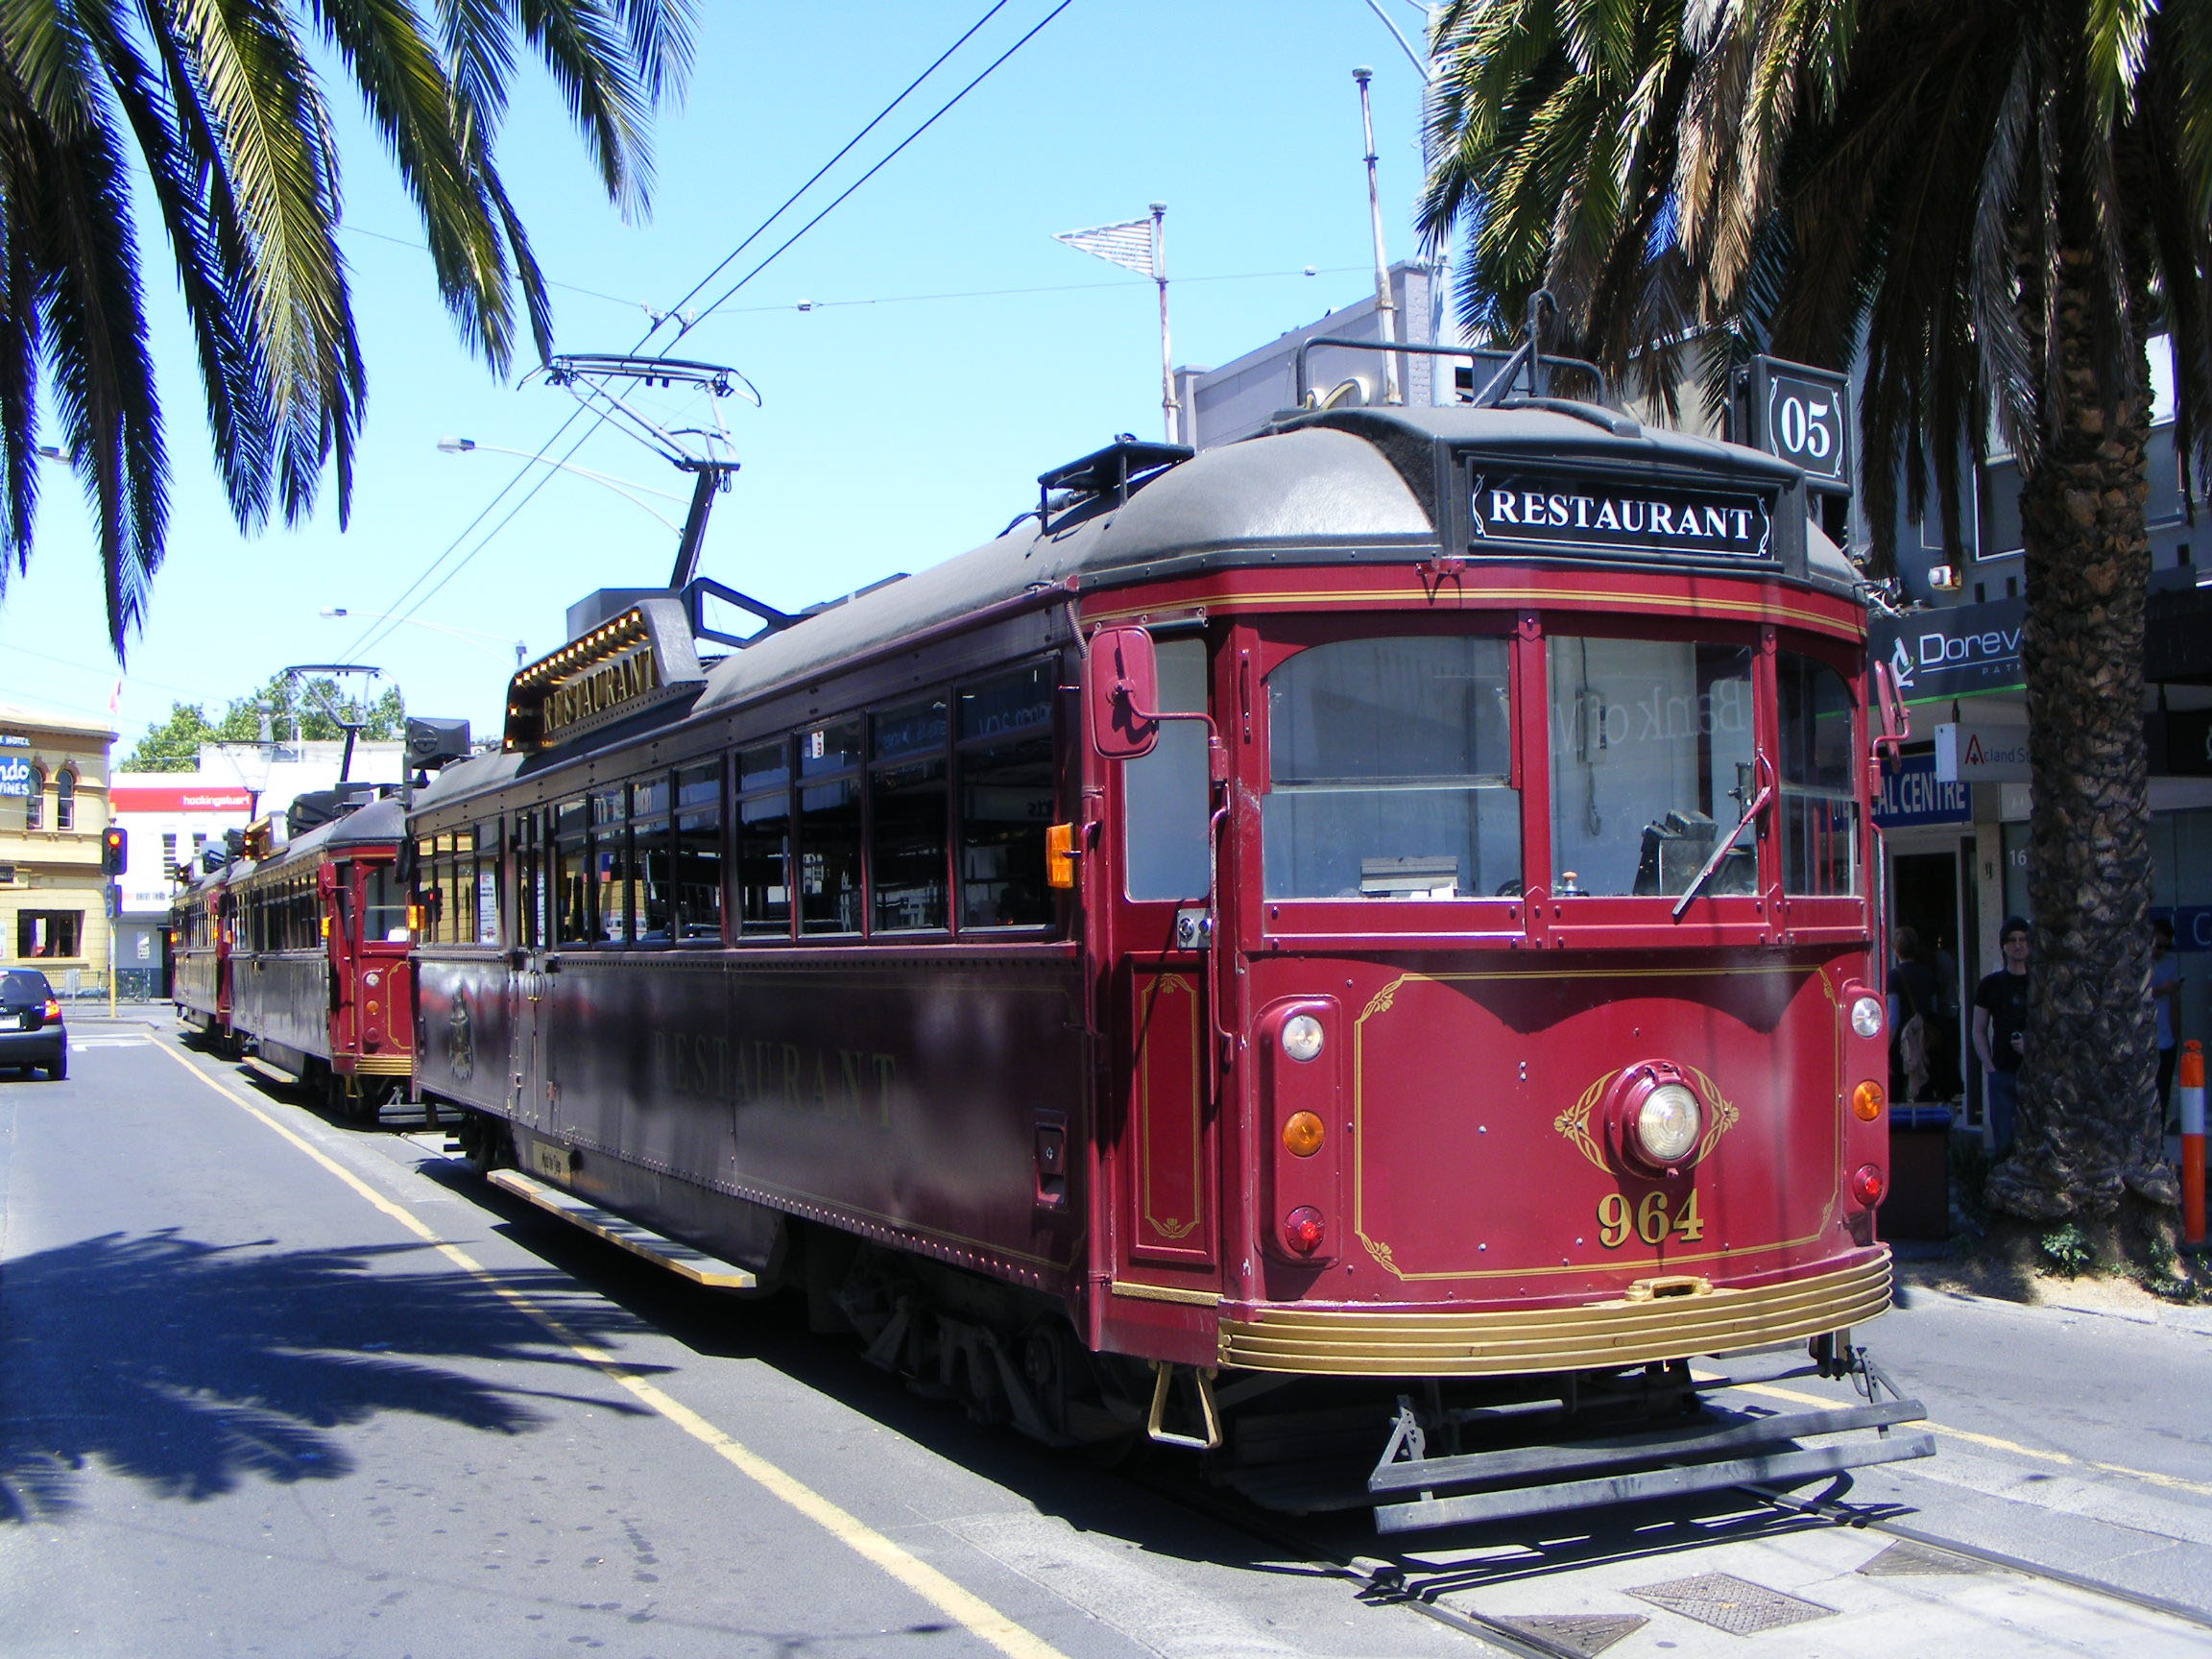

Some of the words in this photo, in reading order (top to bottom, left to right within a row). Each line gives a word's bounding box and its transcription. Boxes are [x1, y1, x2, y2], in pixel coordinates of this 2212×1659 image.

[1781, 397, 1831, 459] 05
[1490, 489, 1753, 540] RESTAURANT
[543, 645, 654, 733] RESTAURANT
[1964, 733, 2015, 764] Acland
[1900, 771, 1966, 814] CENTRE
[653, 1029, 897, 1129] RESTAURANT
[1597, 1187, 1704, 1247] 964
